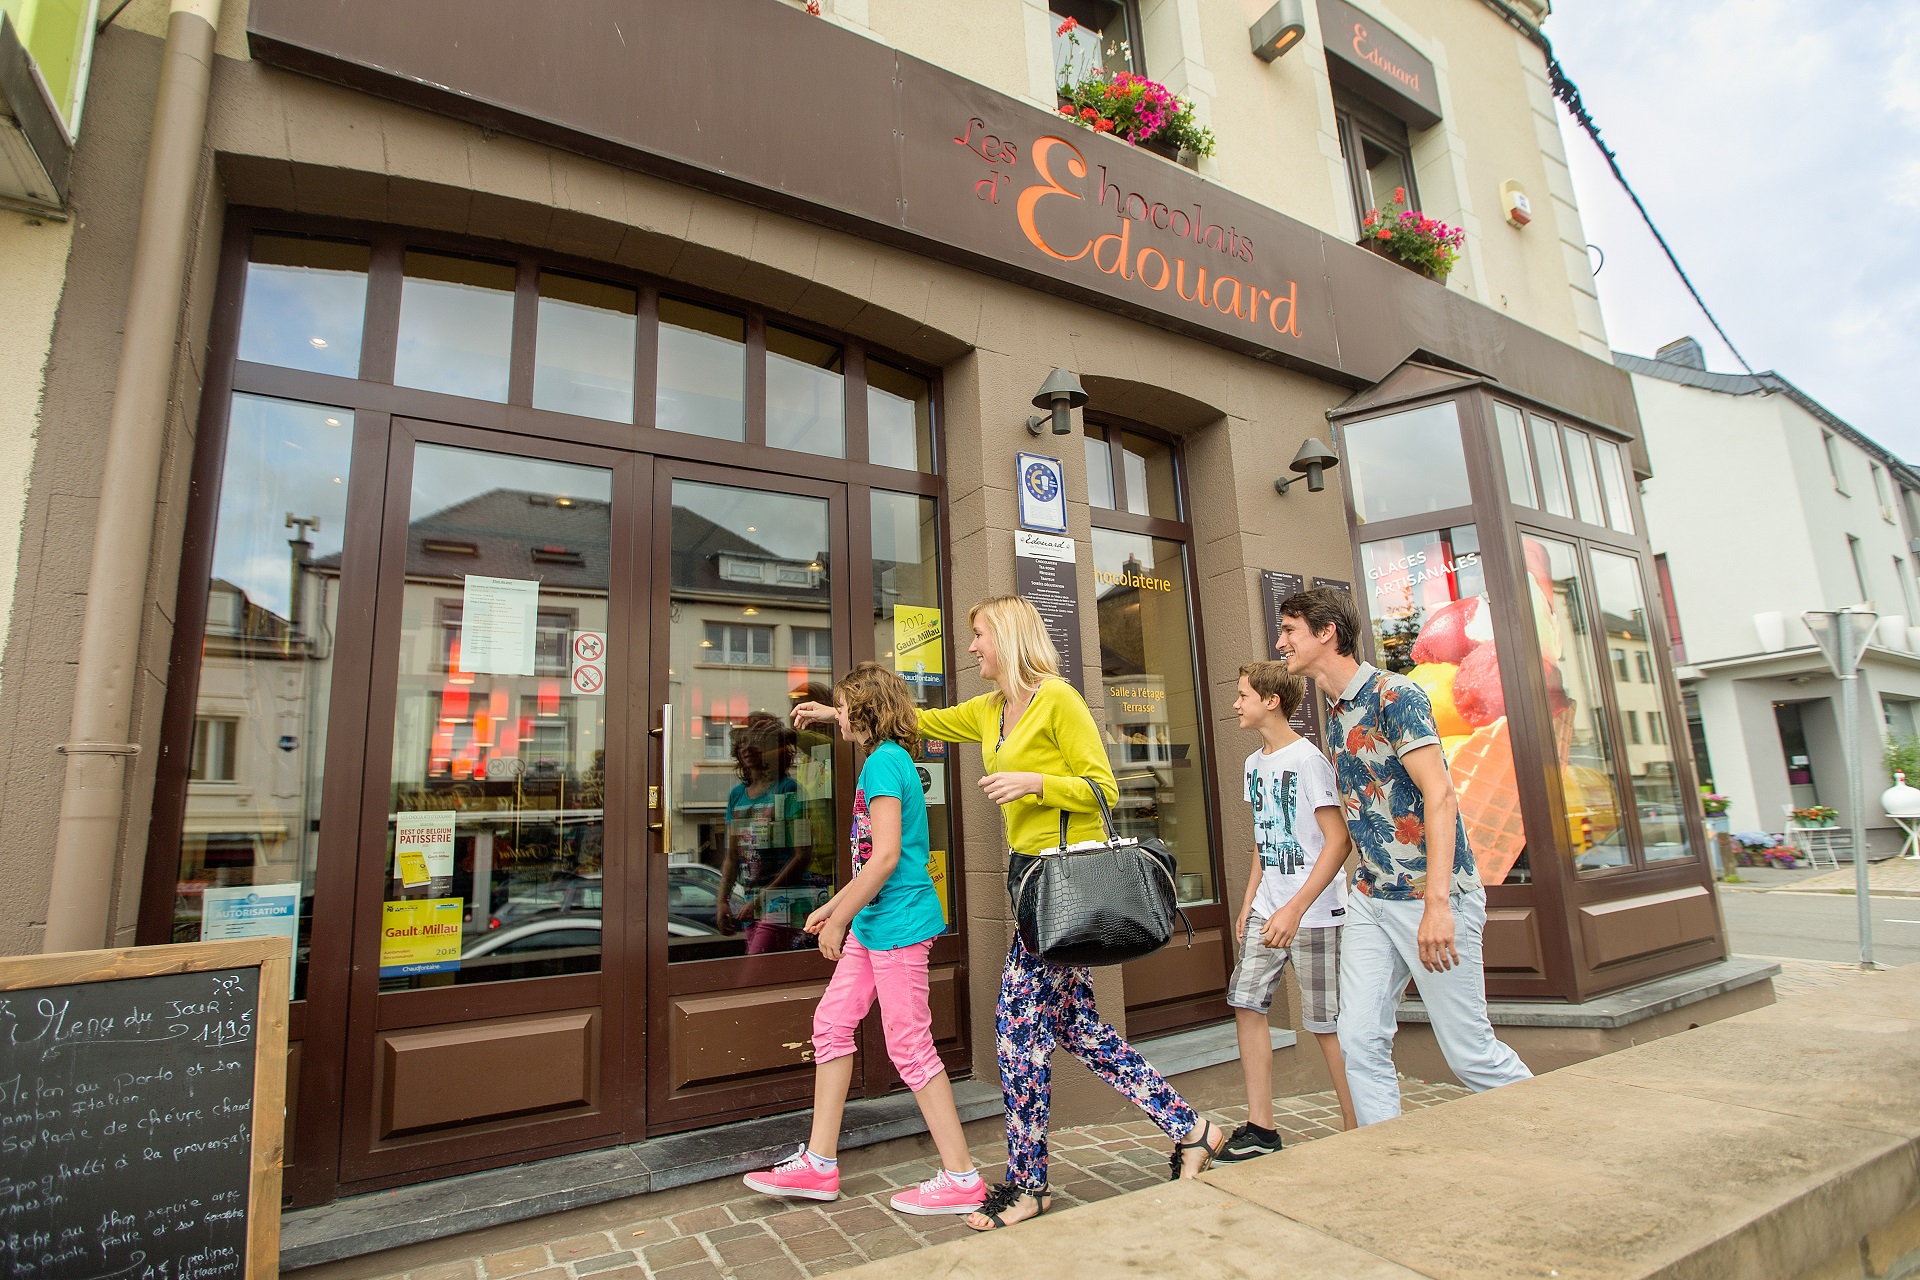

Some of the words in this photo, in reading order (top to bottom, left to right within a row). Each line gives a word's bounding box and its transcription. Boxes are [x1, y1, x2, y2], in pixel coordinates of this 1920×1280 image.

[1352, 23, 1420, 92] Edouard
[953, 117, 1018, 165] Les
[1016, 134, 1303, 339] Edouard
[1025, 533, 1066, 549] Edouard
[1367, 551, 1427, 581] GLACES
[1093, 564, 1171, 592] hocolaterie
[1375, 552, 1479, 598] ARTISANALES
[899, 613, 927, 633] 2012
[1110, 686, 1130, 697] Salle
[1137, 687, 1165, 701] l'étage
[1122, 701, 1155, 713] Terrasse
[400, 833, 452, 844] PATISSERIE
[426, 827, 452, 835] BELGIUM
[216, 906, 288, 918] AUTORISATION
[435, 947, 457, 957] 2015
[402, 964, 441, 973] Chaudfontaine
[124, 1006, 153, 1028] du
[76, 1083, 99, 1094] au
[114, 1067, 173, 1093] Porto
[3, 1108, 61, 1125] ambon
[104, 1121, 127, 1135] de
[143, 1147, 163, 1160] la
[62, 1226, 84, 1238] au
